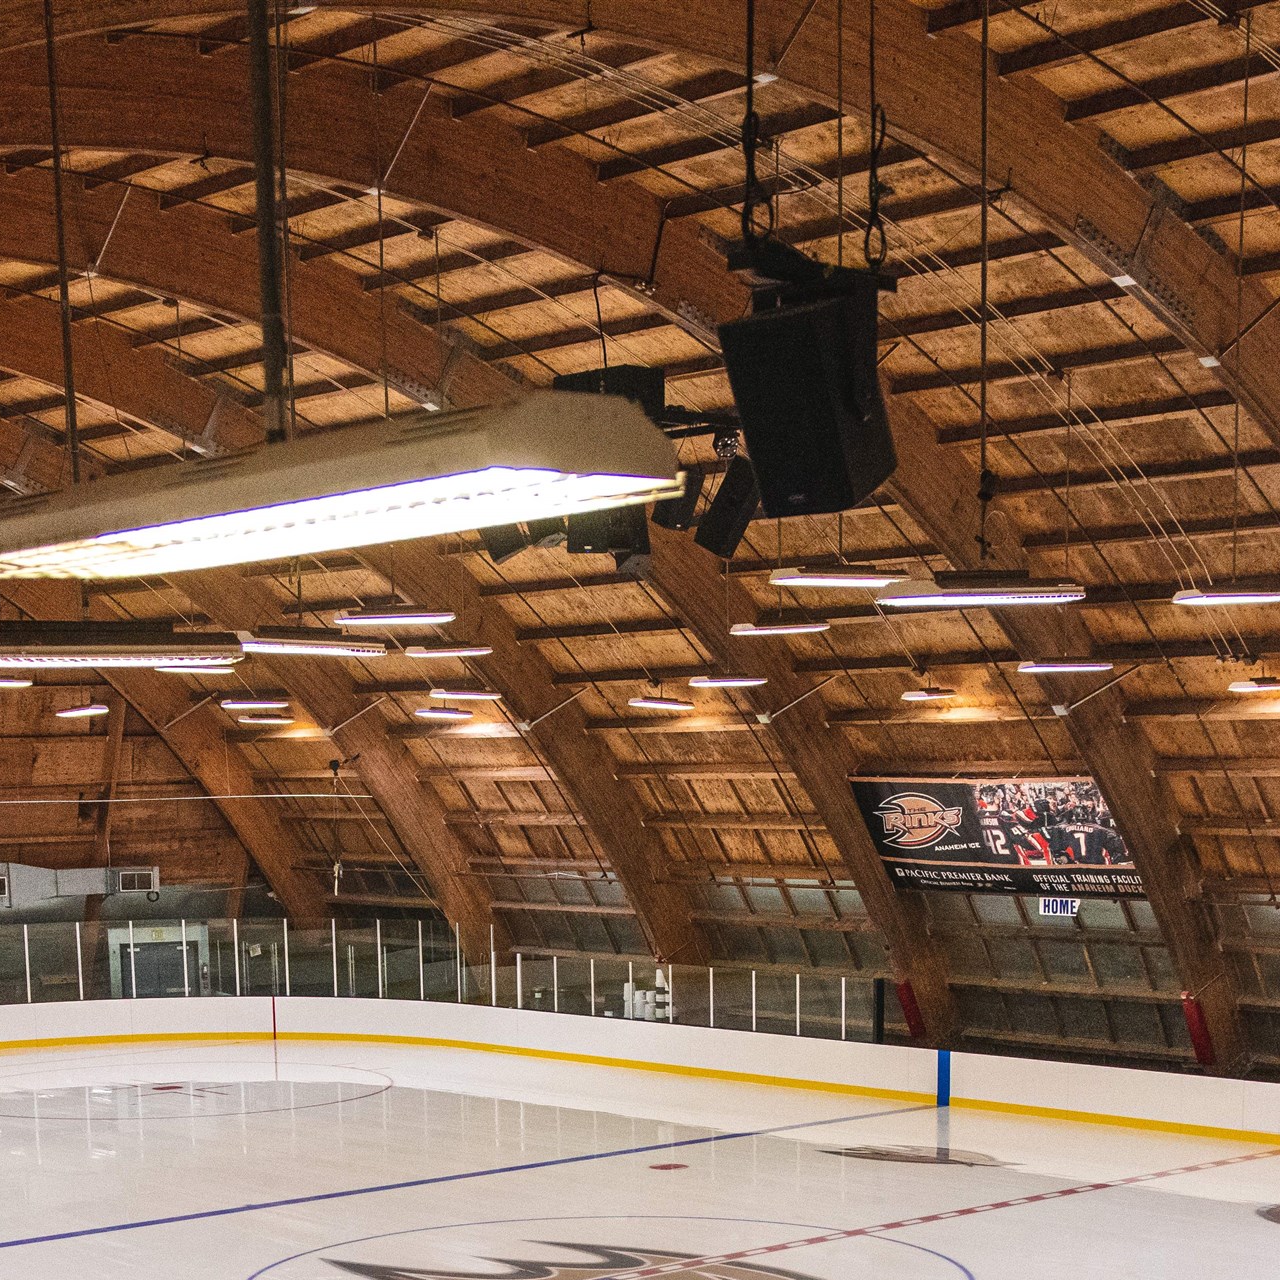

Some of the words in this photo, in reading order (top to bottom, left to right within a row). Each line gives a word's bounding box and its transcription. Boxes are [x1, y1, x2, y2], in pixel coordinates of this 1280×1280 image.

[907, 806, 927, 814] THE
[934, 843, 968, 852] ANAHEIM
[1073, 832, 1086, 857] 7
[905, 869, 941, 880] PACIFIC
[941, 871, 984, 881] PREMIER
[984, 873, 1013, 882] BANK
[1032, 874, 1070, 883] OFFICIAL
[1071, 874, 1111, 884] TRAINING
[1112, 875, 1143, 883] FACILIT
[1040, 883, 1050, 891] OF
[1052, 883, 1070, 892] THE
[1071, 884, 1116, 893] ANAHEIM
[1117, 885, 1145, 893] DUCK
[1043, 898, 1077, 915] HOME
